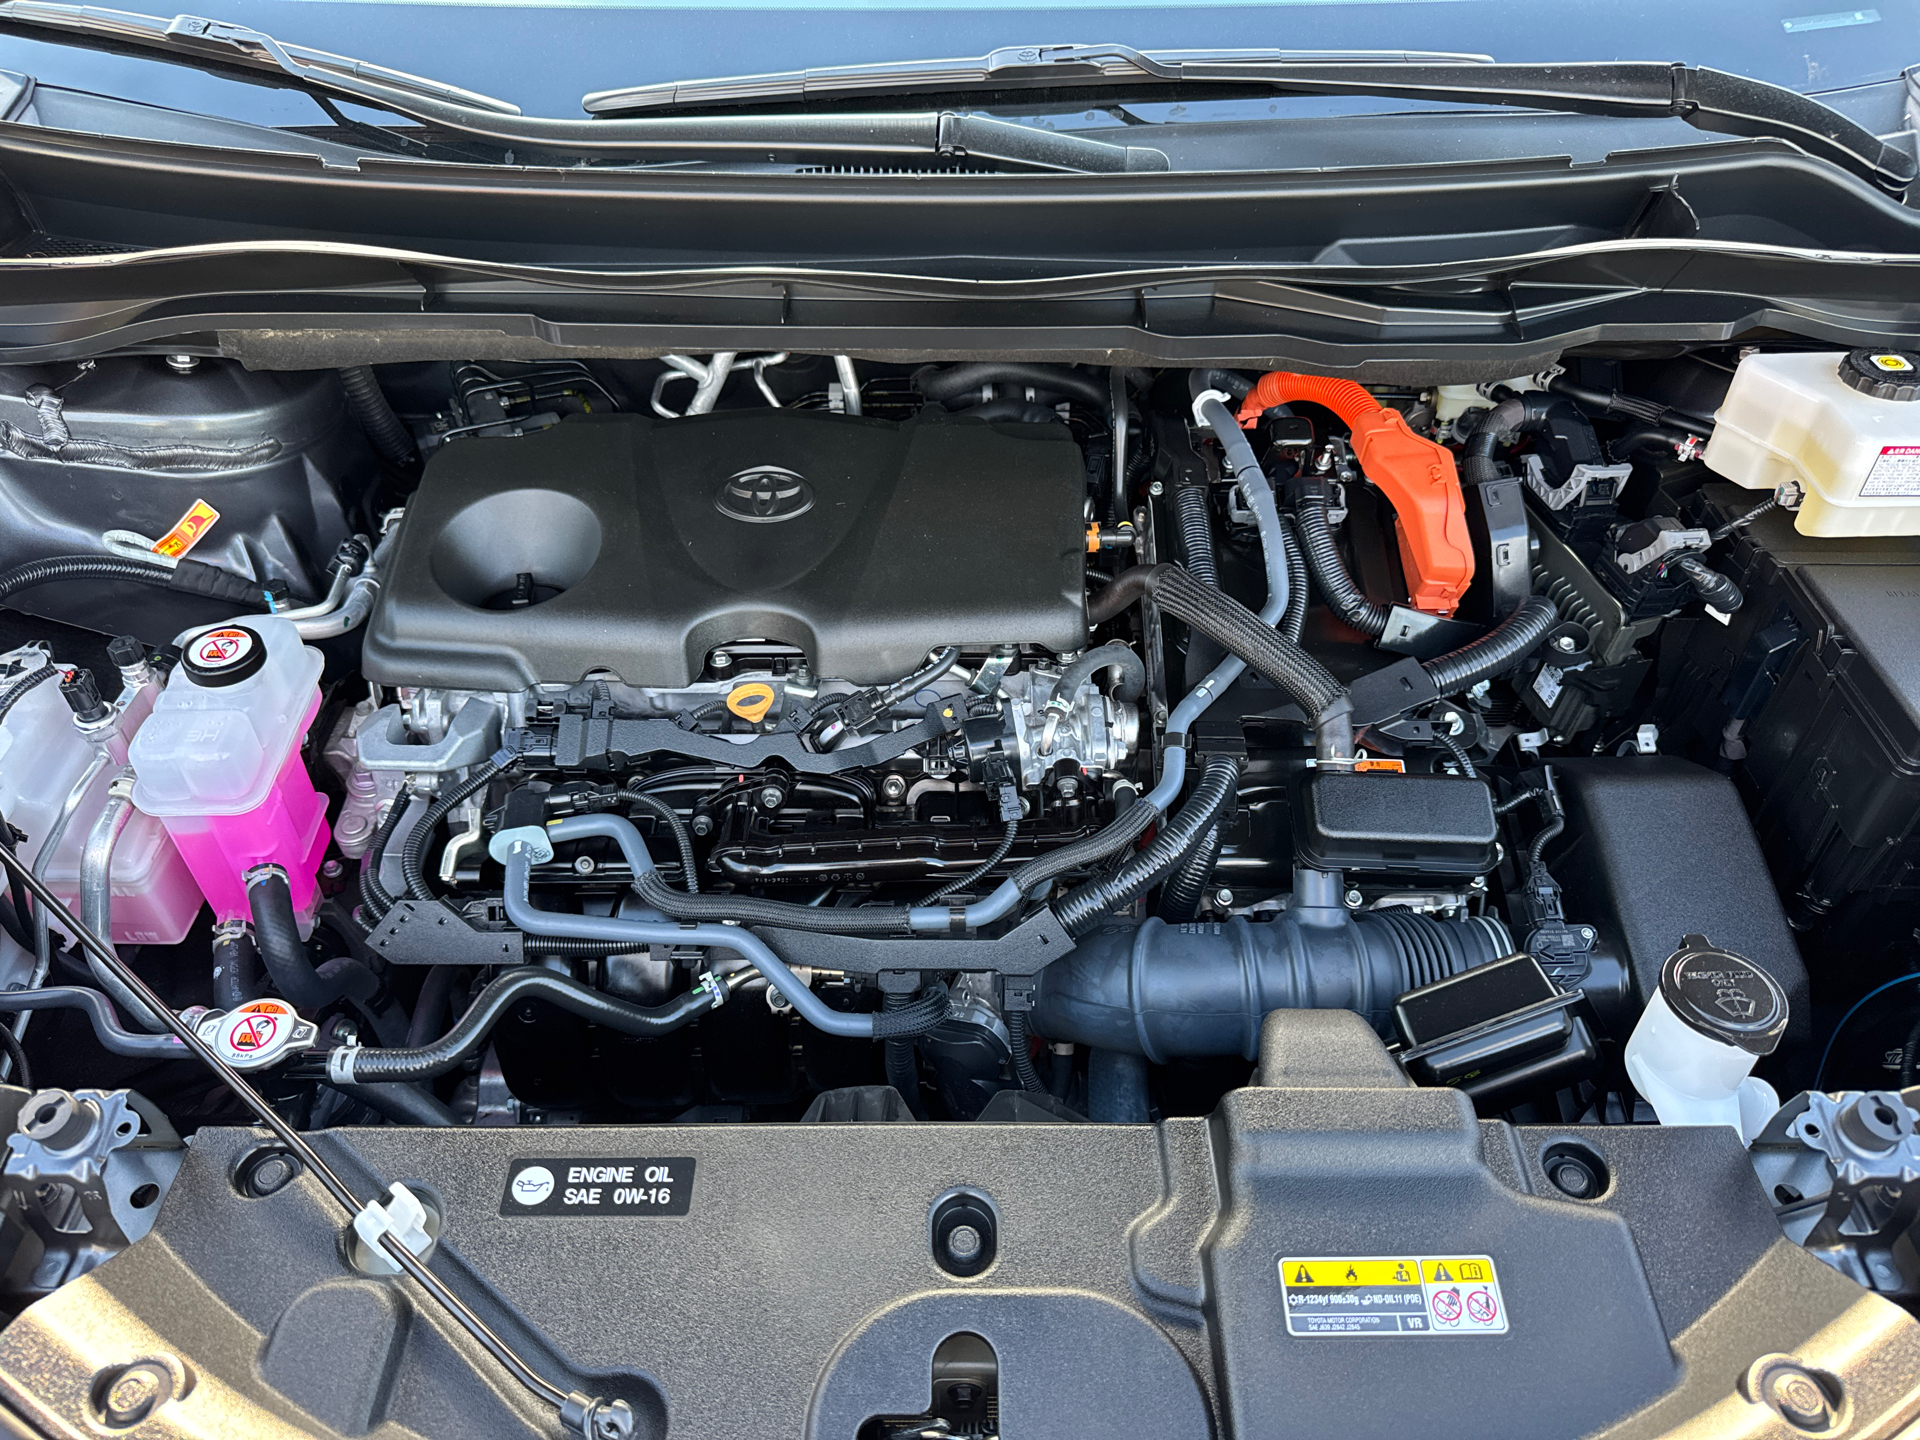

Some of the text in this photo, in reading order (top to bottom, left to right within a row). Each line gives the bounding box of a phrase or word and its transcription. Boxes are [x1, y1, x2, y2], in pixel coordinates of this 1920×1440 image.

[567, 1166, 674, 1183] ENGINE OIL
[563, 1188, 671, 1205] SAE 0W-16
[1407, 1317, 1424, 1329] VR
